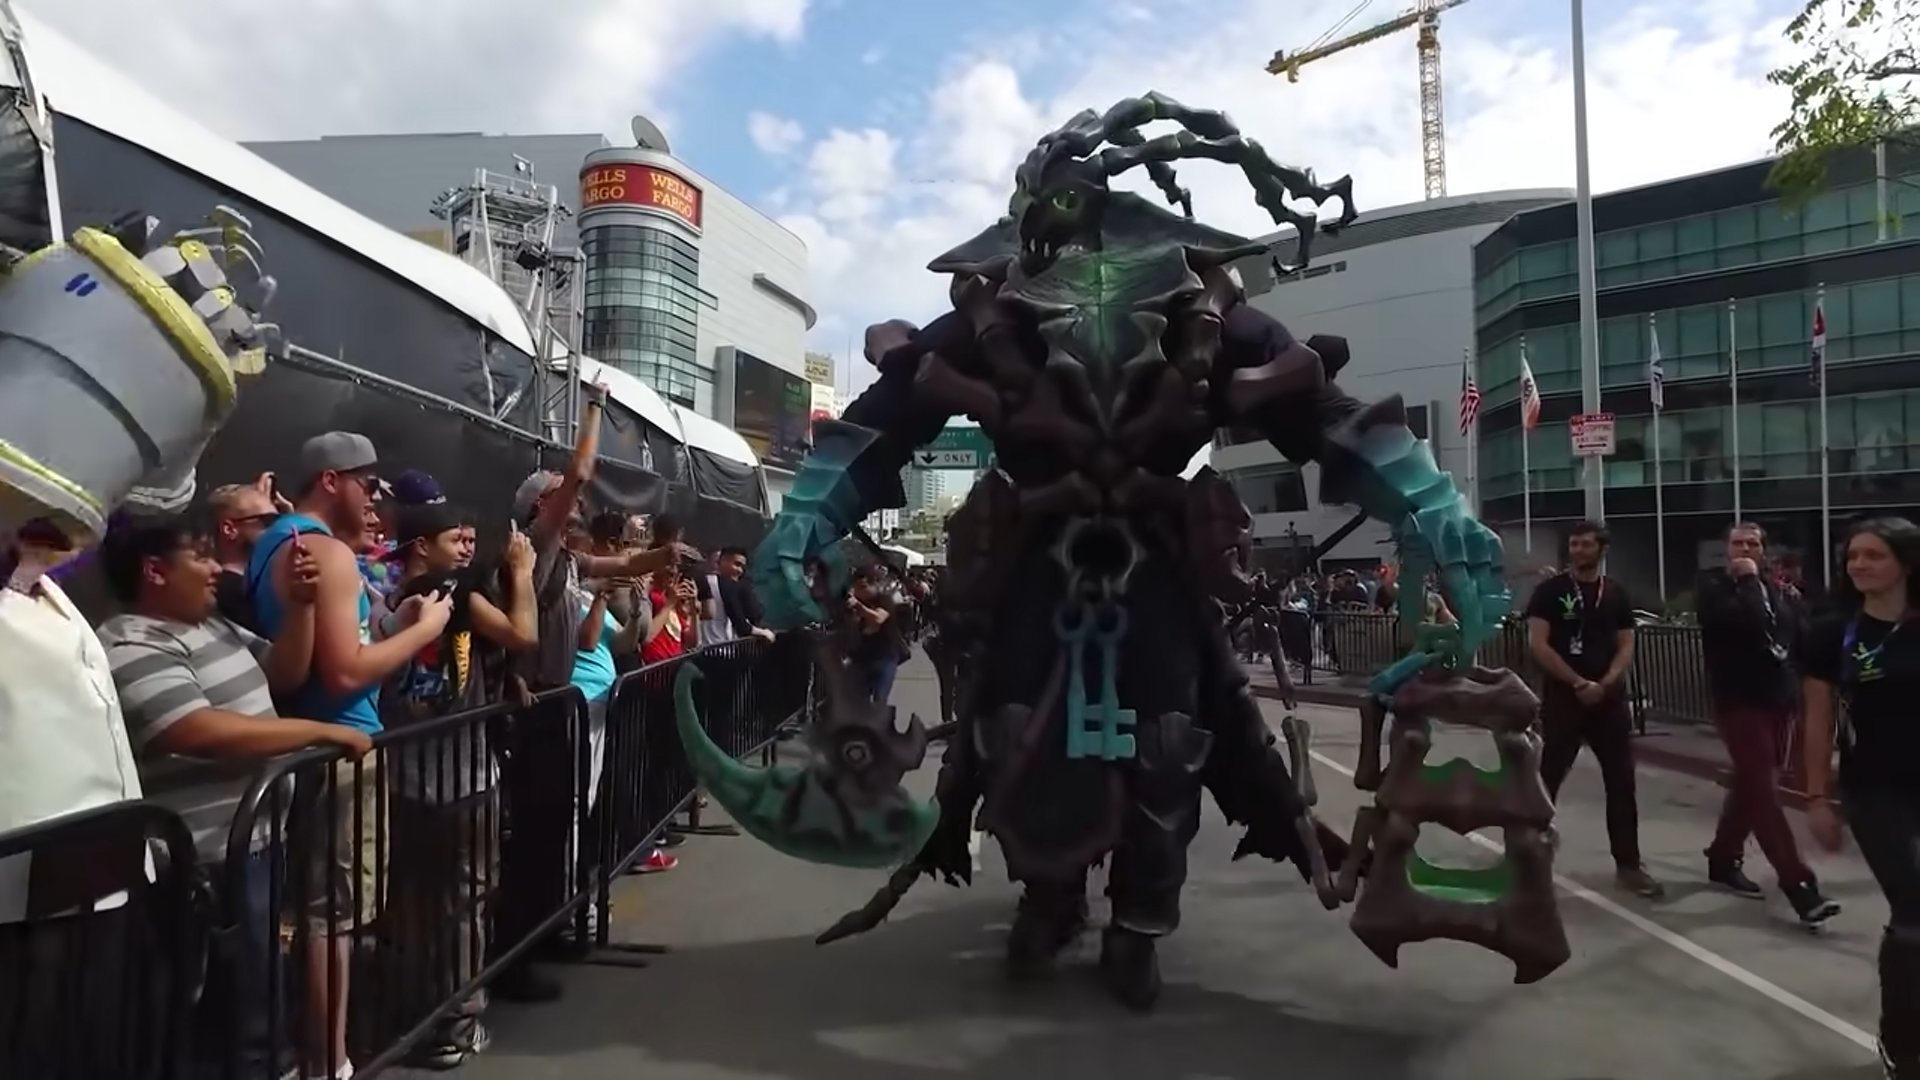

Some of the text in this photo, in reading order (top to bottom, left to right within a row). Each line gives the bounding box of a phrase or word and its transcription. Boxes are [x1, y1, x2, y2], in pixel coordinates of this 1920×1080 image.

[584, 169, 626, 187] ELLS
[584, 185, 625, 203] ARGO
[649, 172, 694, 203] WELLS
[652, 190, 692, 218] FARGO
[944, 453, 971, 462] ONLY
